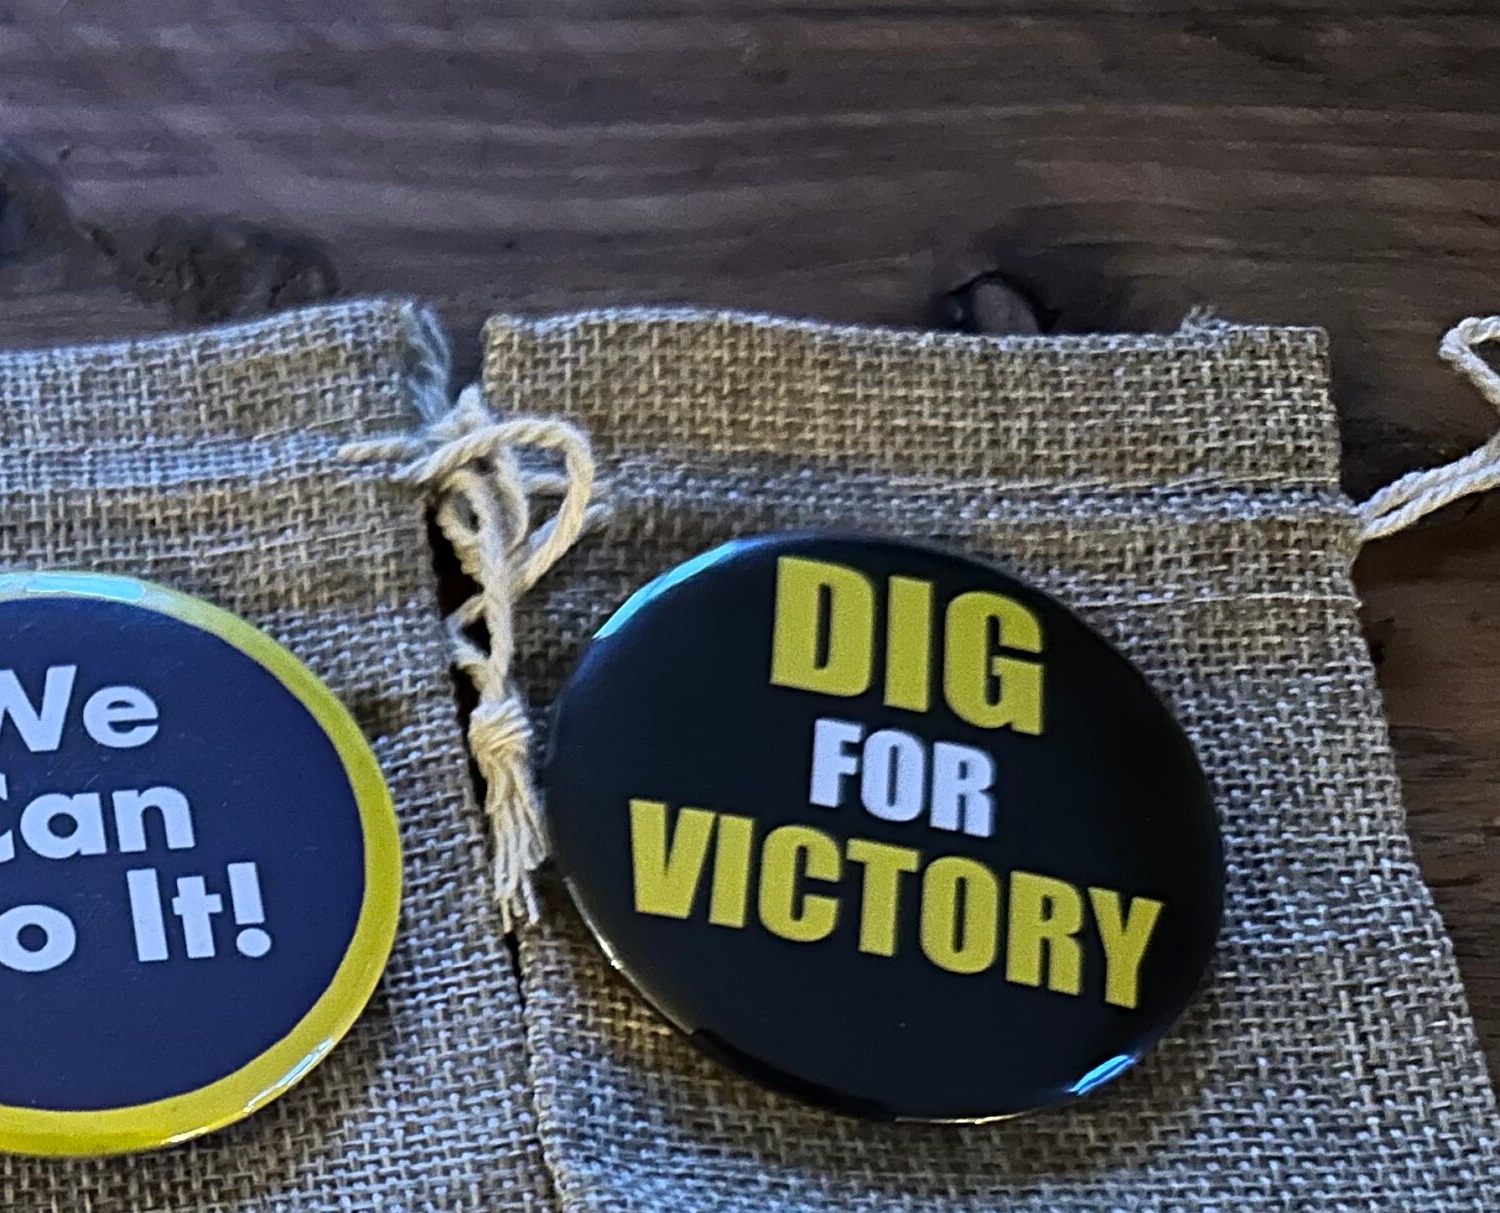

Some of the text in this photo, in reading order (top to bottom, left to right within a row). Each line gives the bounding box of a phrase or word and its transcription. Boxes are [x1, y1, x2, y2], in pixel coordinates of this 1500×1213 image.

[768, 553, 1046, 737] DIG
[808, 716, 997, 839] FOR
[124, 859, 274, 964] It!
[627, 796, 1166, 1011] VICTORY
